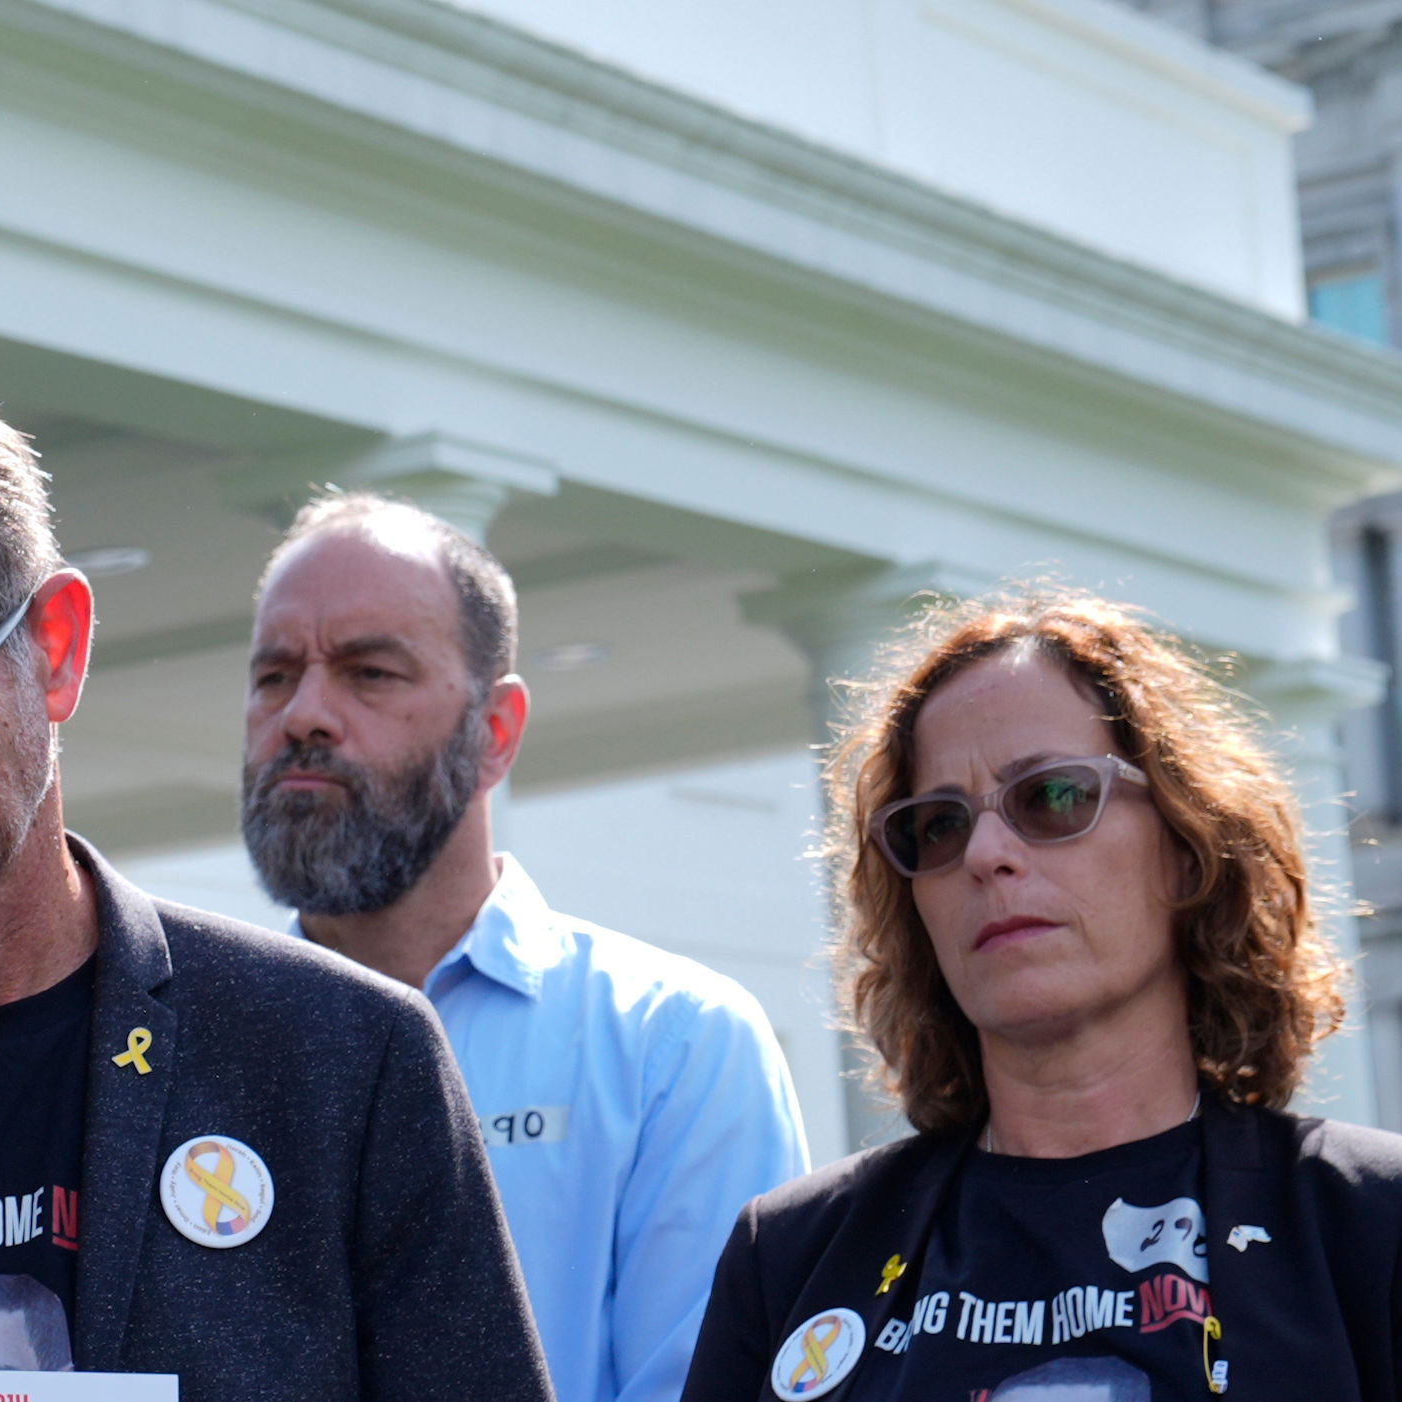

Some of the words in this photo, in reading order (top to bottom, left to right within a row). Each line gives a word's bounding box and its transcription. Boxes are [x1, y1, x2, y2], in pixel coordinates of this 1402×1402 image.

[480, 1111, 543, 1144] 90
[956, 1291, 1045, 1345] THEM
[1052, 1285, 1135, 1345] HOME
